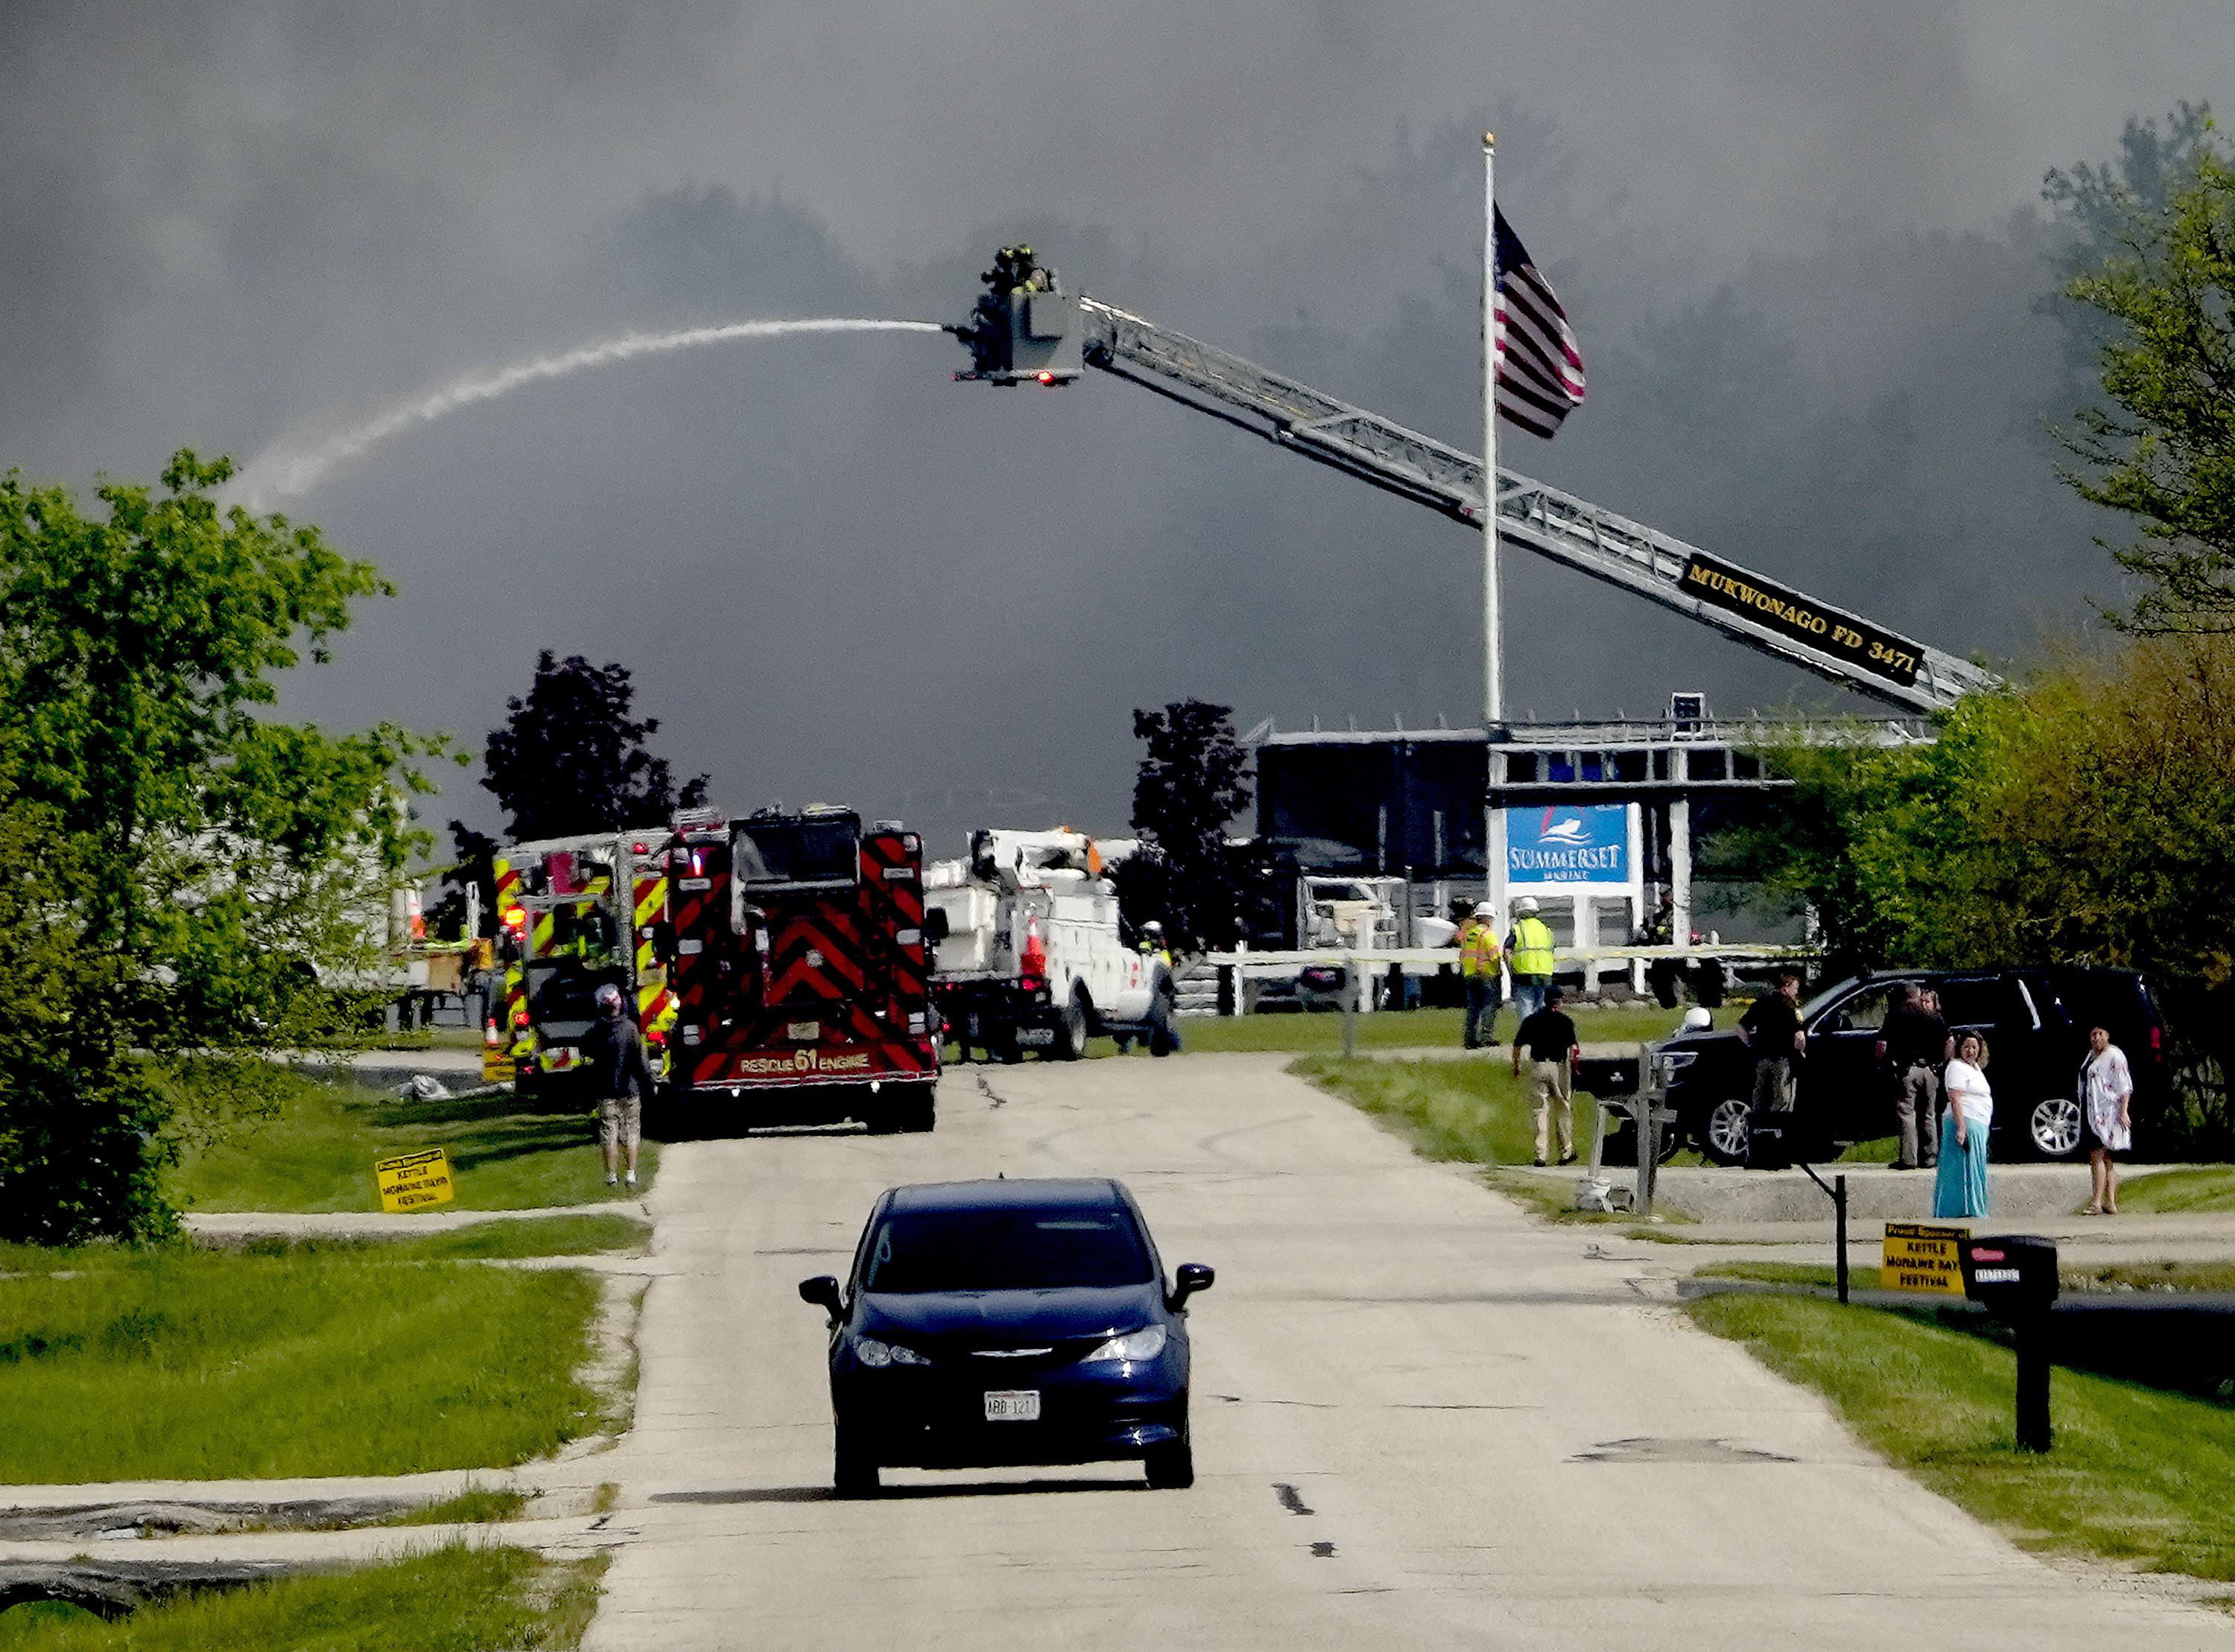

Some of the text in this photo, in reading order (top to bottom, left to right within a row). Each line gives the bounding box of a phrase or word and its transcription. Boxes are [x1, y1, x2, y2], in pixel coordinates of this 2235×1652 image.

[1688, 564, 1915, 673] MUKWONAGO FD 3471
[1510, 845, 1621, 871] SUMMERSET
[741, 1049, 871, 1073] RESCUE 61 ENGINE
[1907, 1242, 1947, 1255] KETTLE
